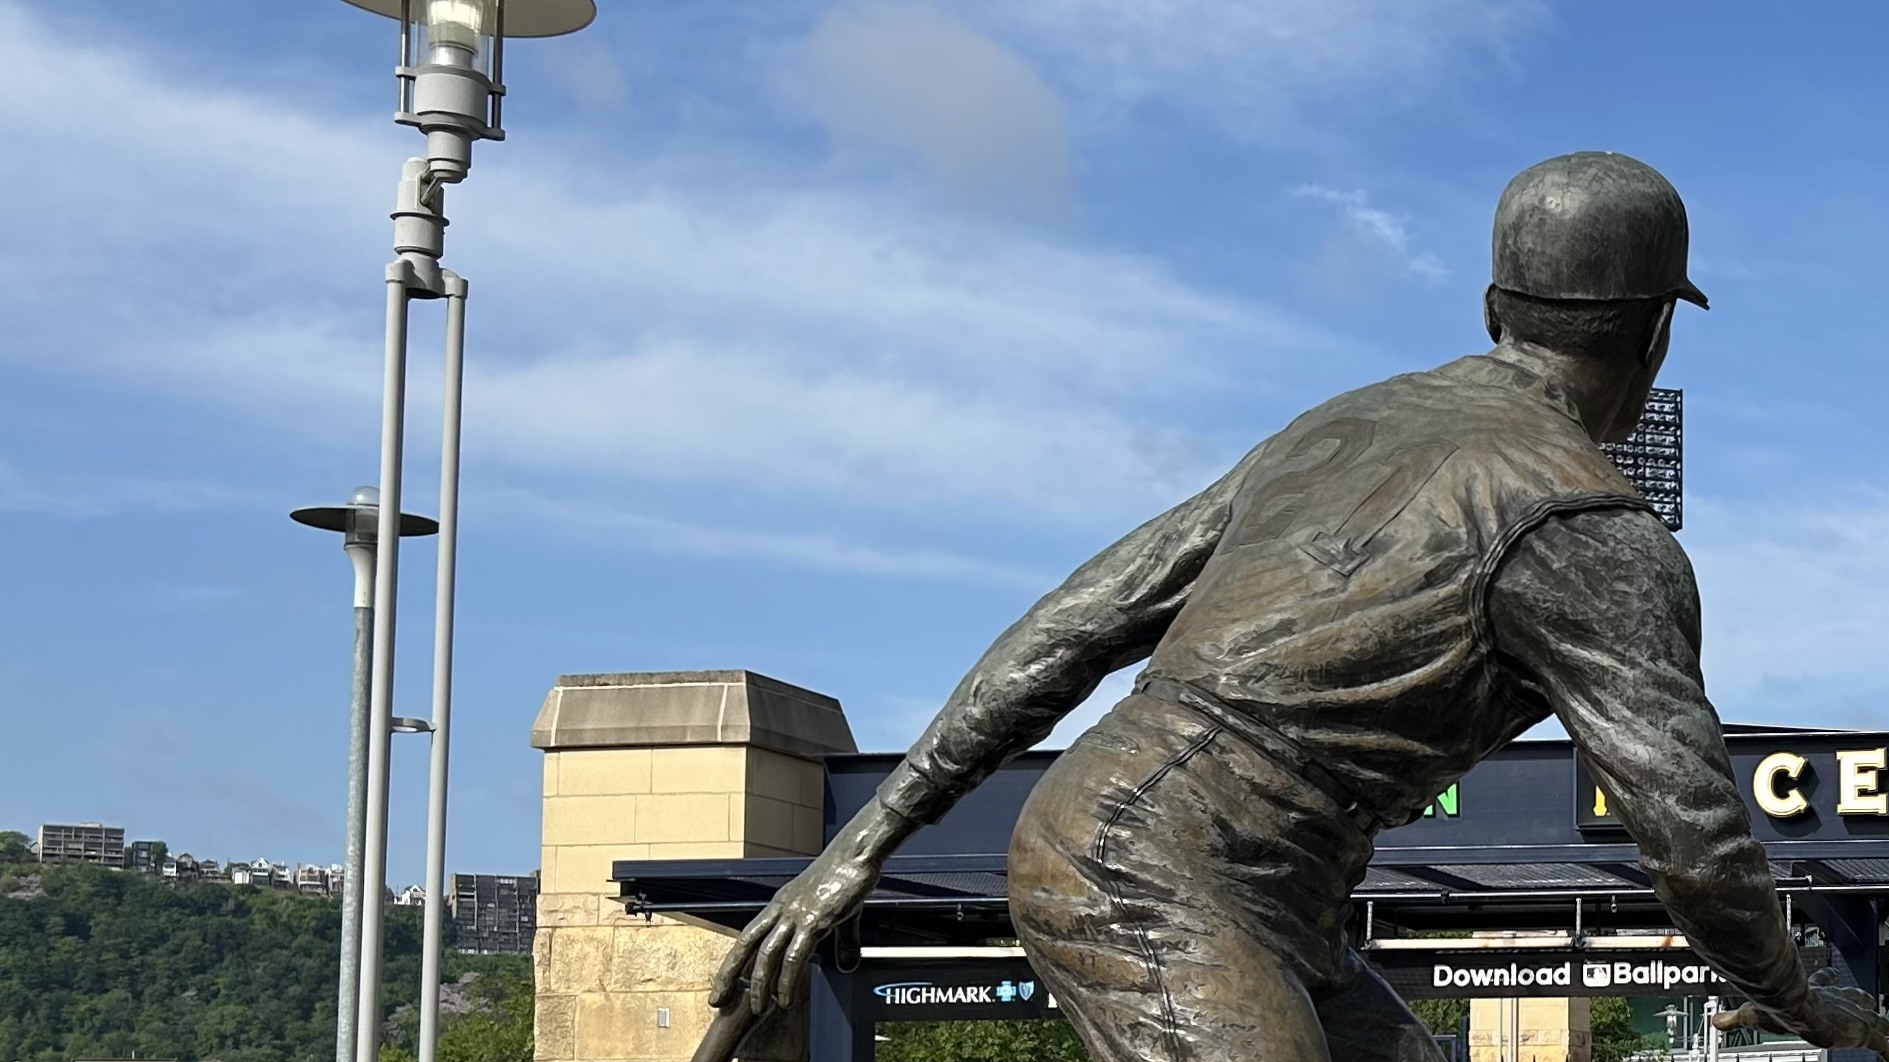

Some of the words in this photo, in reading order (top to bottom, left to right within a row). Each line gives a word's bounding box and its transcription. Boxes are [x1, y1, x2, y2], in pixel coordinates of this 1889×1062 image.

[1222, 417, 1460, 577] 21
[1433, 960, 1571, 988] Download
[885, 985, 993, 1005] HIGHMARK
